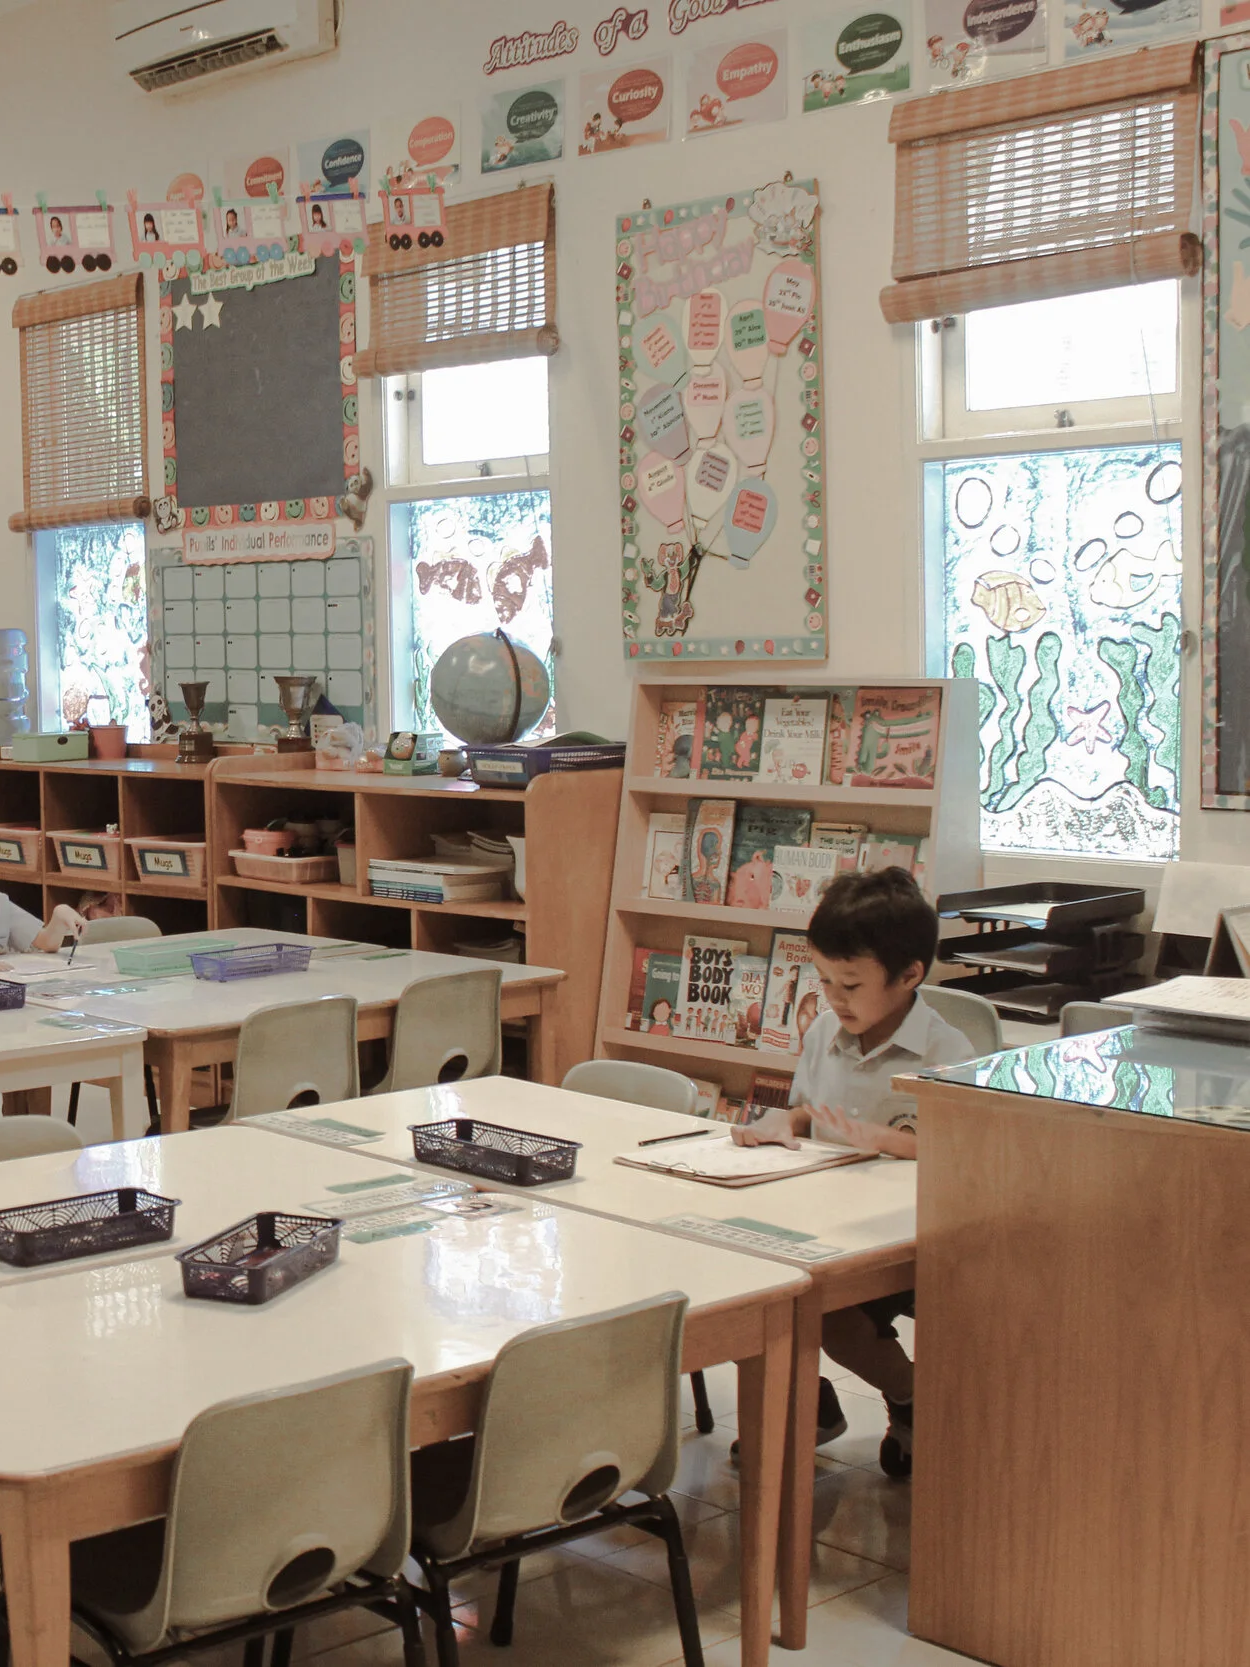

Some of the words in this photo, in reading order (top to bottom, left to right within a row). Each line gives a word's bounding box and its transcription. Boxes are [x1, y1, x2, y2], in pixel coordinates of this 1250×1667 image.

[966, 0, 1037, 28] Independence
[484, 22, 579, 73] Attitudes
[596, 9, 625, 54] of
[629, 10, 648, 39] a
[838, 30, 902, 55] Enthusiasm
[722, 60, 773, 81] Empathy
[612, 84, 658, 104] Curiosity
[510, 107, 556, 127] Creativity
[409, 131, 453, 149] Cooperation
[324, 152, 363, 169] Confidence
[245, 169, 283, 186] Commitment
[192, 275, 206, 291] The
[210, 272, 227, 288] Best
[230, 268, 254, 286] Group
[257, 266, 265, 280] of
[269, 263, 284, 277] the
[288, 256, 314, 275] Week
[190, 535, 218, 553] Puils'
[221, 533, 266, 551] Indidual
[269, 531, 329, 549] Perfoance
[781, 707, 794, 717] Eat
[764, 729, 785, 739] Drink
[75, 850, 92, 864] Mugs
[154, 856, 173, 870] Mugs
[808, 850, 833, 870] BODY
[778, 940, 813, 953] Amazi
[690, 947, 733, 967] BOY'S
[689, 964, 735, 986] BODY
[687, 983, 733, 1006] BOOK
